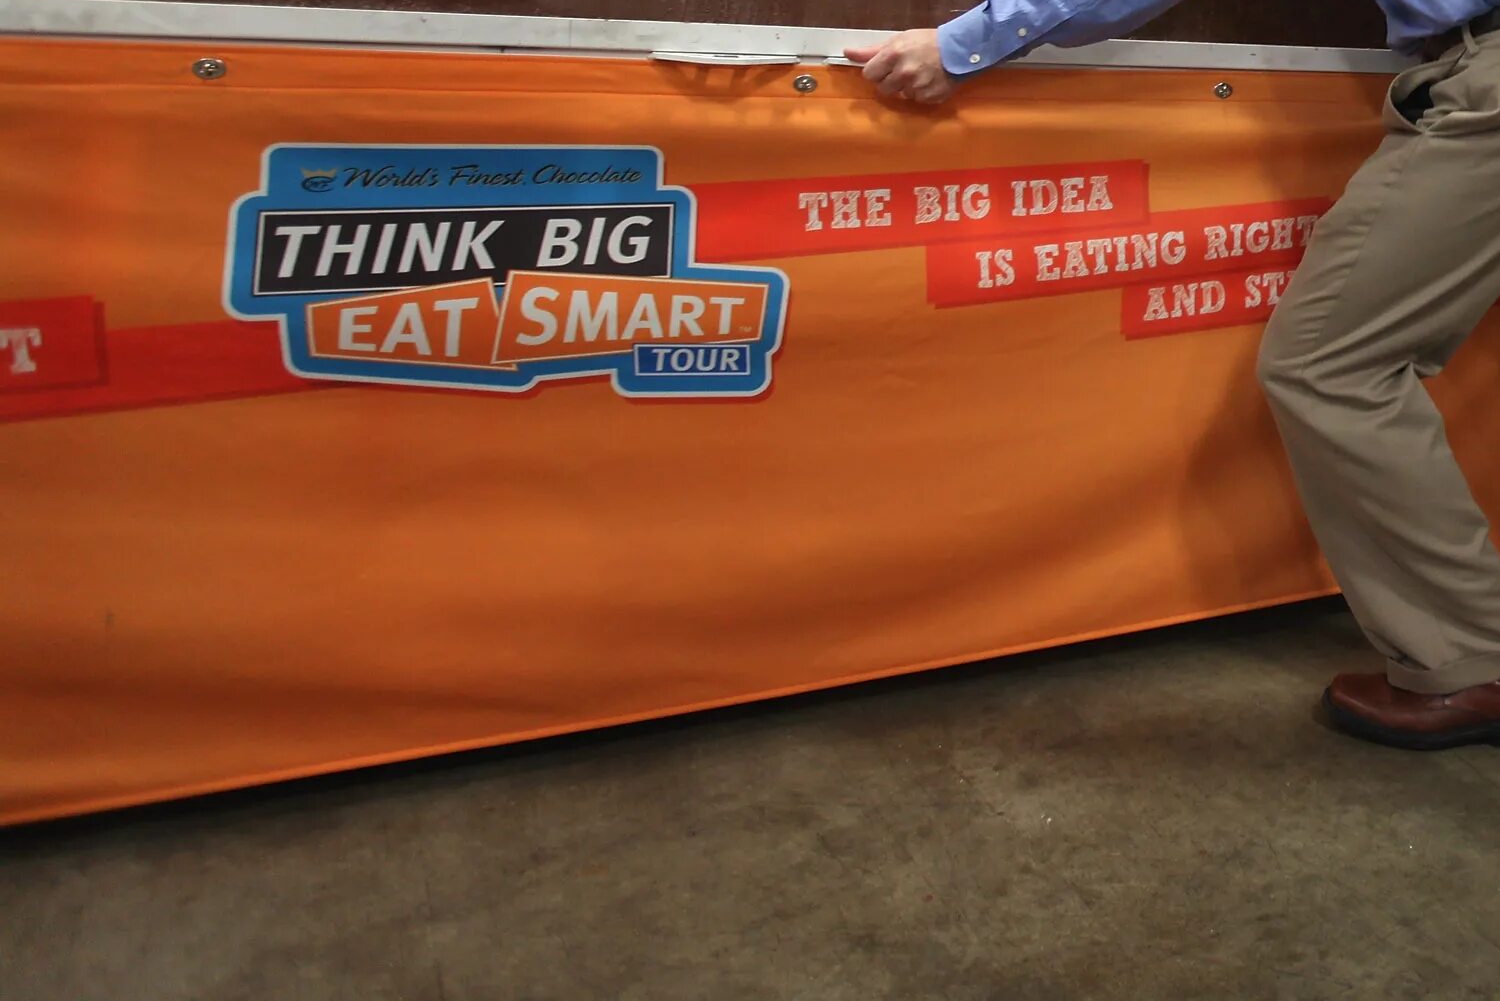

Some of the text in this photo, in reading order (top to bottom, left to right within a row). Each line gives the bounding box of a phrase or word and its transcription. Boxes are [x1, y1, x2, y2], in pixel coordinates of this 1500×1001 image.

[344, 164, 440, 188] World's
[448, 164, 524, 187] Finest
[531, 164, 642, 187] Chocolate
[799, 175, 1113, 231] THE BIG IDEA
[274, 215, 653, 278] THINK BIG
[975, 215, 1319, 288] IS EATING RIGHT
[337, 297, 479, 357] EAT
[515, 286, 744, 346] SMART
[1143, 281, 1226, 321] AND
[651, 347, 740, 373] TOUR
